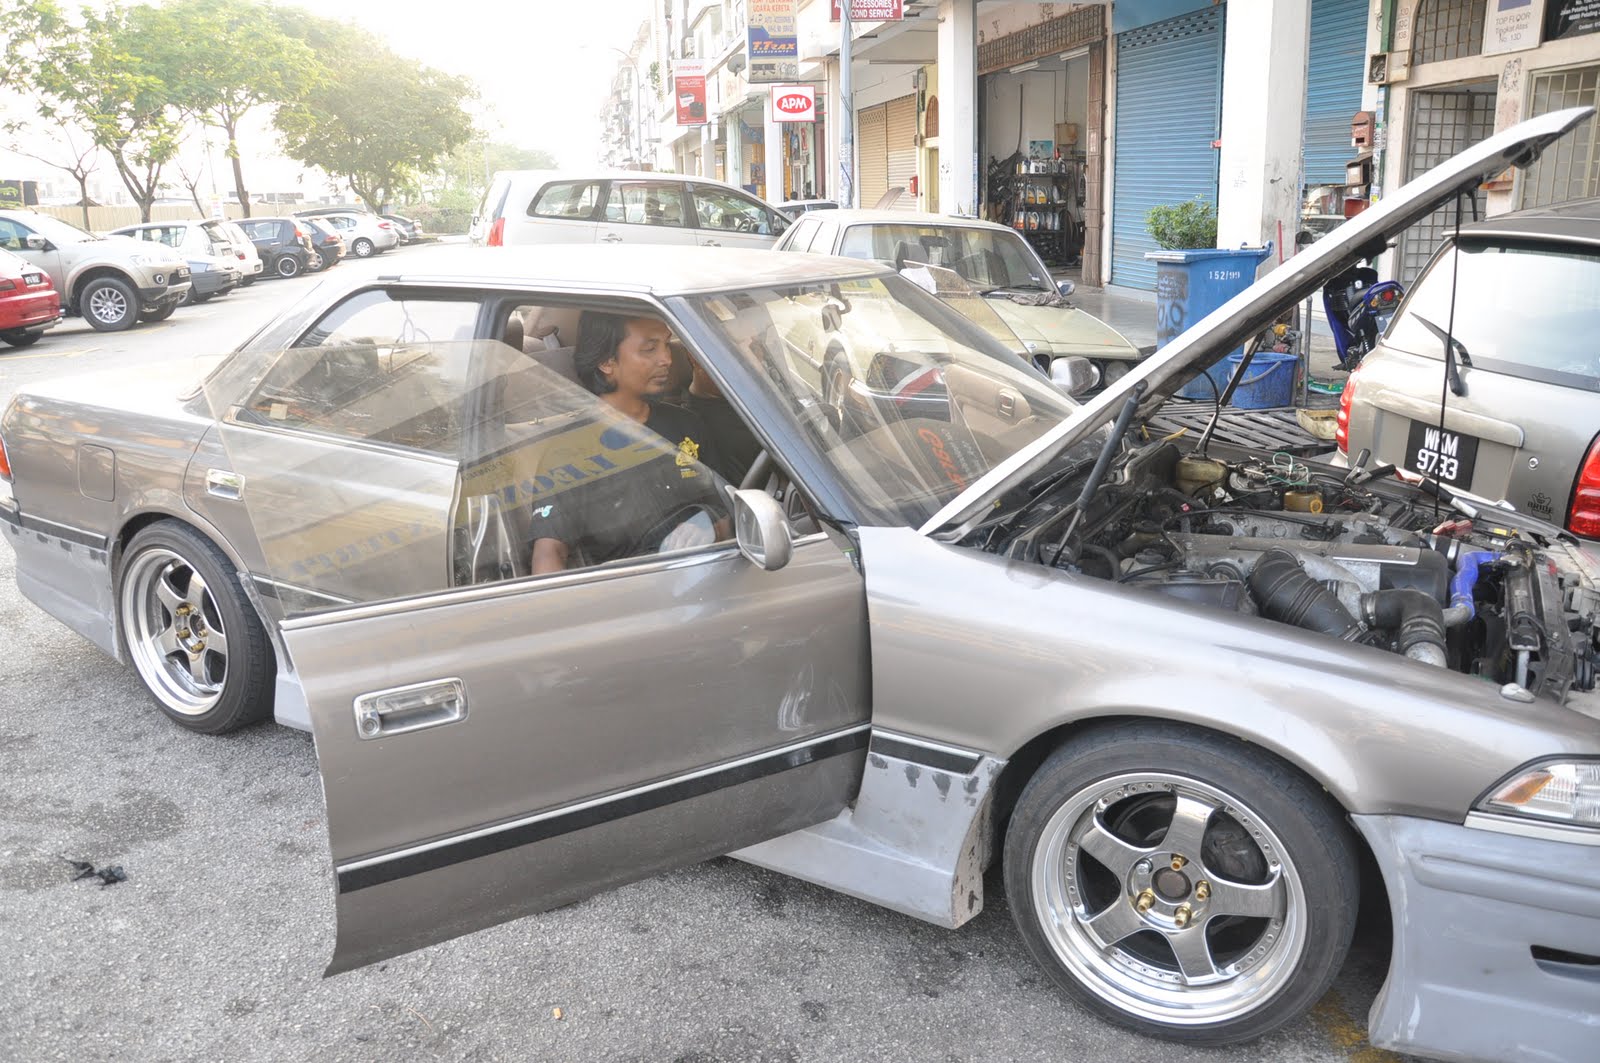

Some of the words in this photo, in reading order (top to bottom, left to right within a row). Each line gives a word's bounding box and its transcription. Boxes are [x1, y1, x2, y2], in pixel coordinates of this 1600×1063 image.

[868, 9, 894, 18] SERVICE
[1508, 12, 1531, 24] FLOOR
[781, 97, 808, 110] APM
[1209, 270, 1241, 281] 152/99
[1424, 427, 1459, 457] WKM
[1416, 448, 1459, 480] 9733
